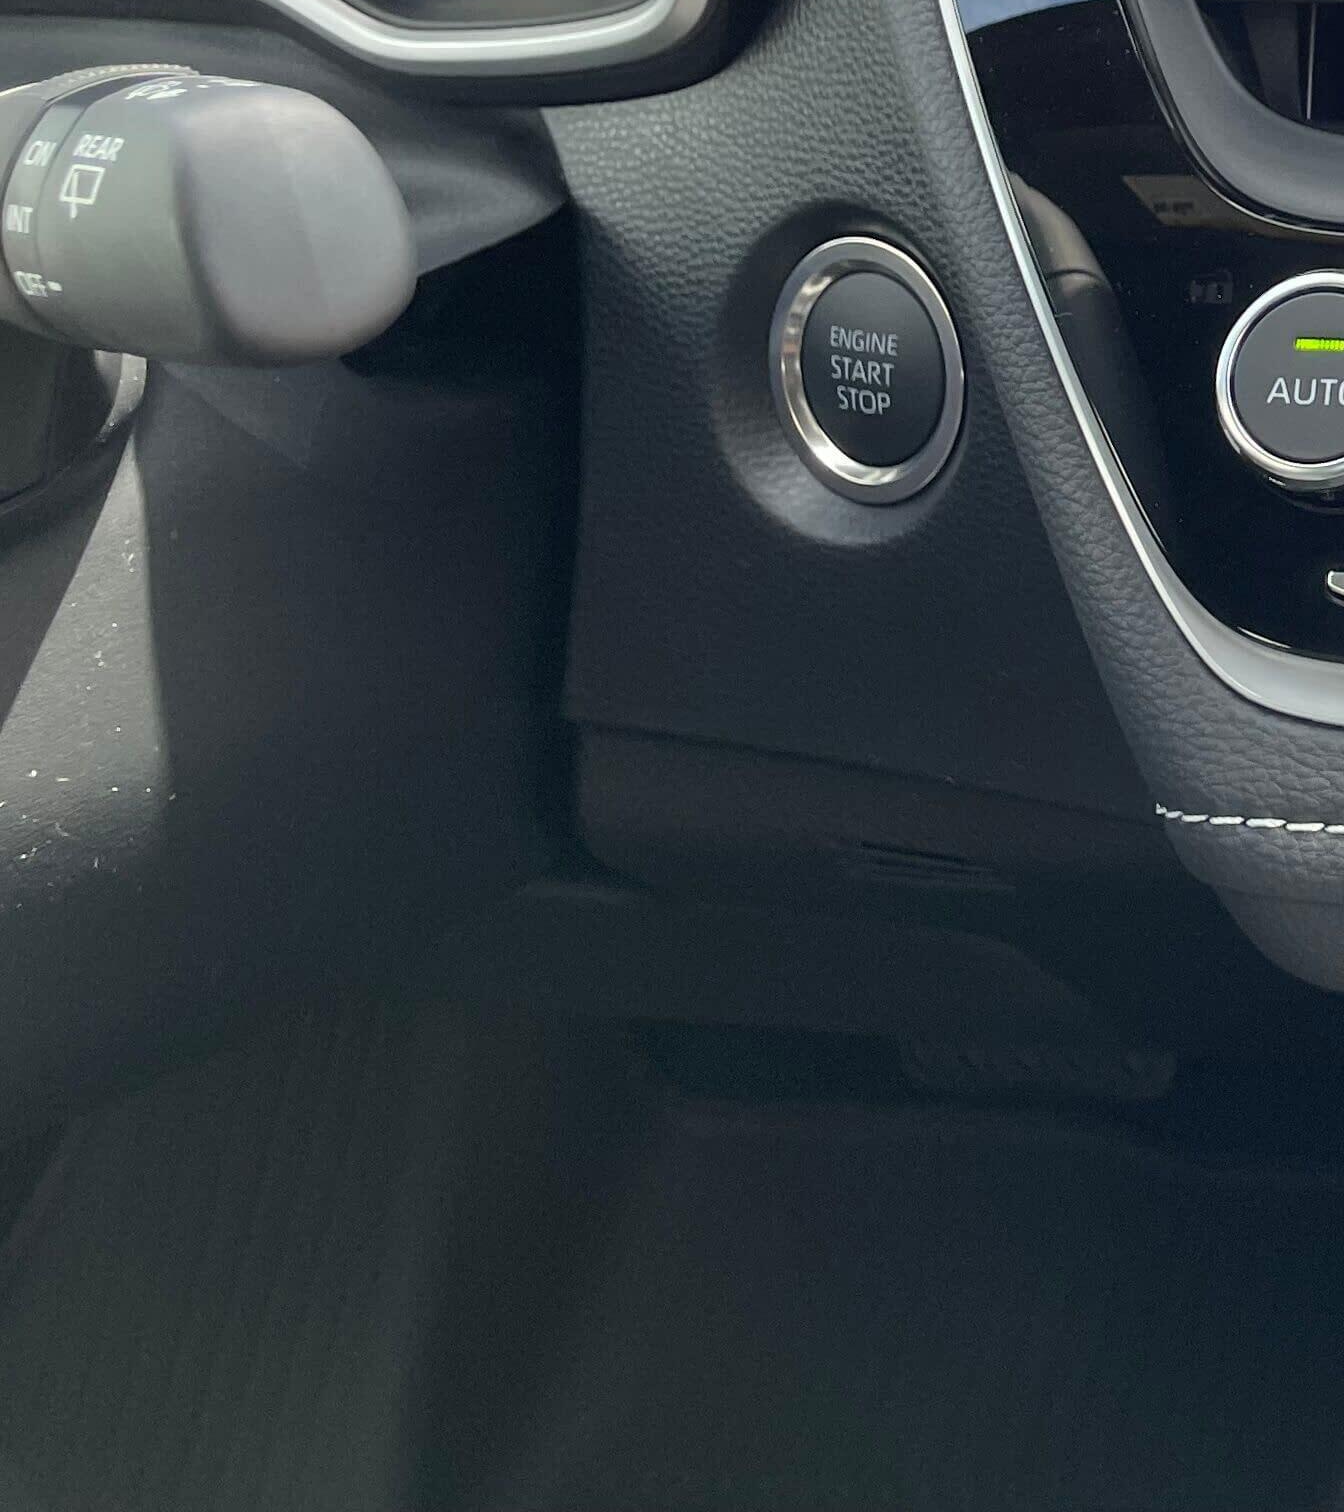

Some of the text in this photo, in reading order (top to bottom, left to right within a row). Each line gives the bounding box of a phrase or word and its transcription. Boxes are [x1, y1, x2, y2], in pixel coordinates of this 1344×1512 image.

[73, 134, 124, 161] REAR
[831, 325, 899, 356] ENGINE
[830, 355, 894, 387] START
[837, 385, 891, 415] STOP
